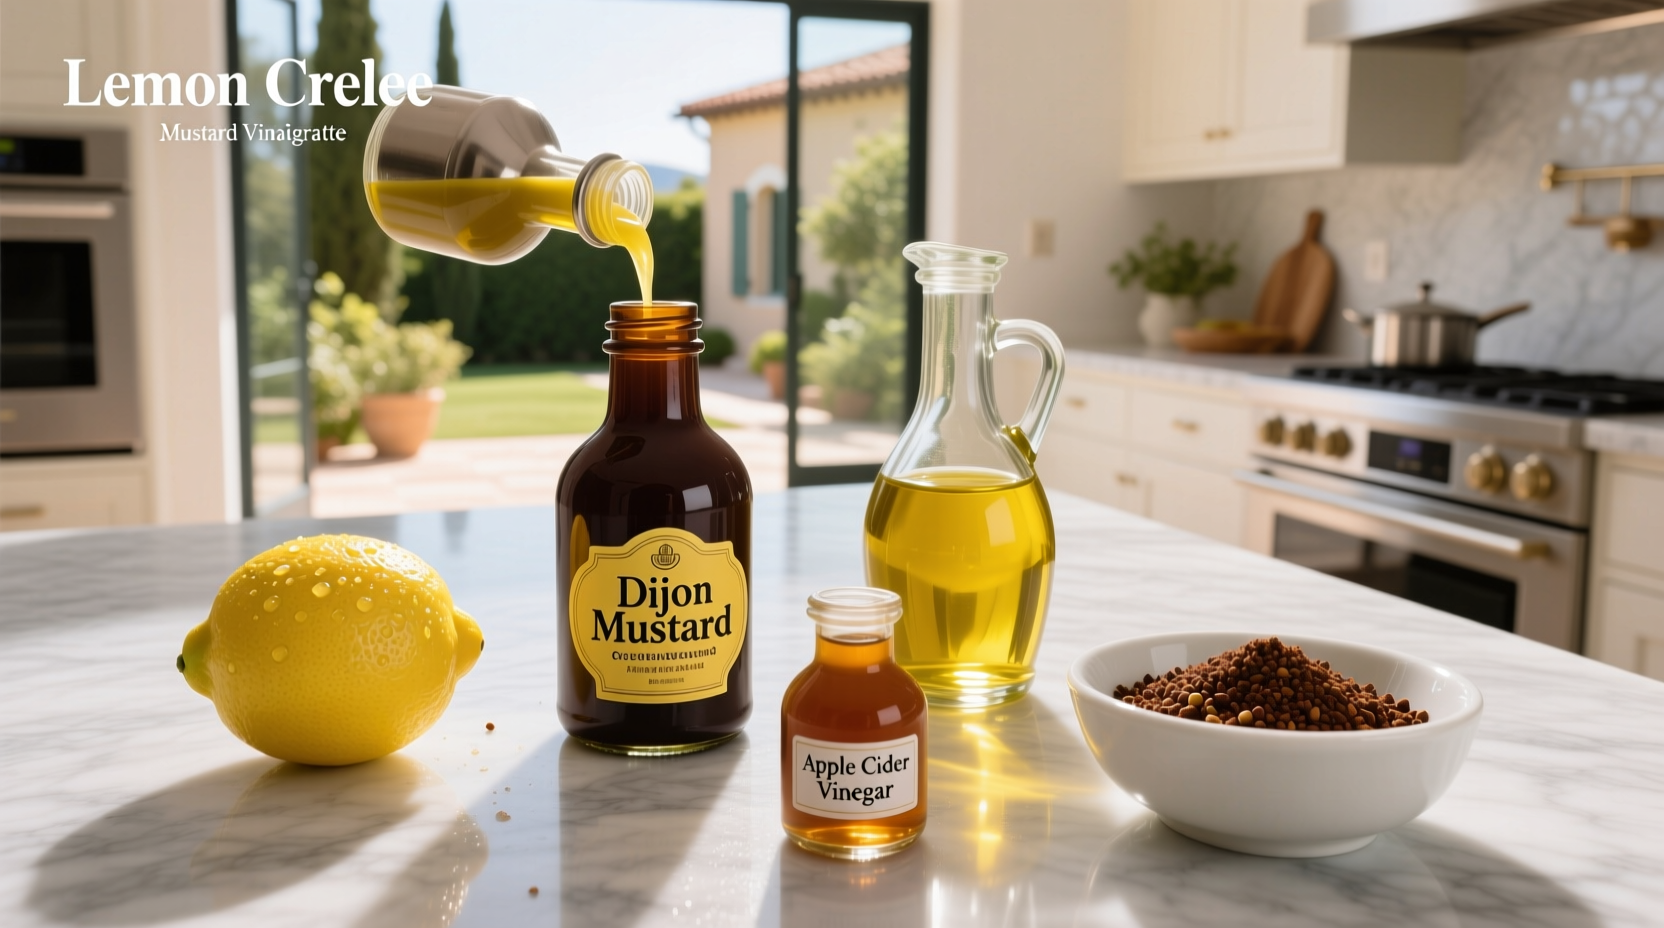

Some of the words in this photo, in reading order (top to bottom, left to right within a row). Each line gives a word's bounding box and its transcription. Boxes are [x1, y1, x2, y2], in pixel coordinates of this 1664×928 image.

[617, 576, 713, 618] Dijon
[591, 603, 732, 644] Mustard
[802, 753, 856, 780] Apple
[861, 754, 910, 775] Cider
[816, 780, 894, 806] Vinegar
